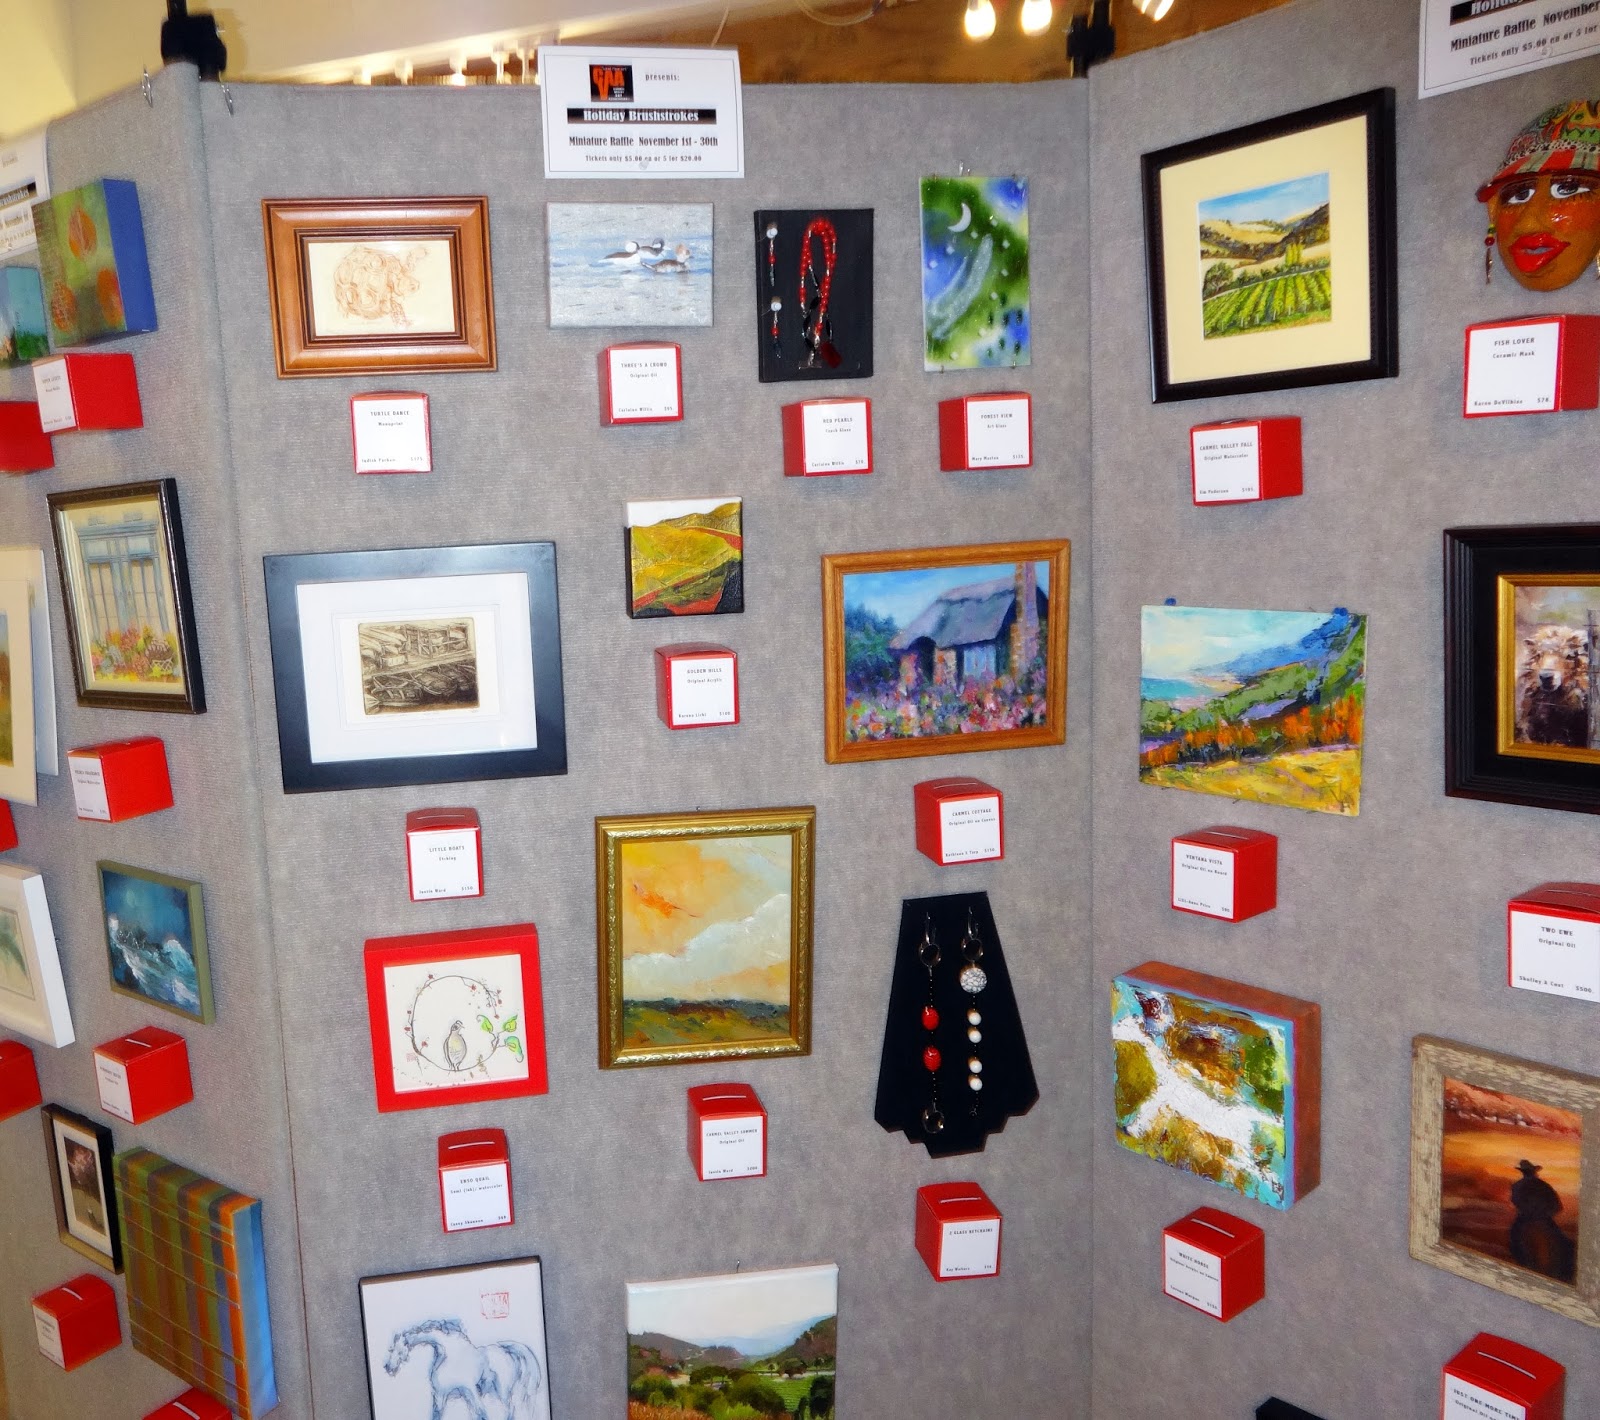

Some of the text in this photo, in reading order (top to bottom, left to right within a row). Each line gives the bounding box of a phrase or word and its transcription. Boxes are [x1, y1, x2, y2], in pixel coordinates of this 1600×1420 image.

[1450, 1, 1600, 51] Miniature Raffle November
[1470, 53, 1499, 65] Tickets
[1501, 46, 1520, 57] only
[1522, 38, 1547, 51] $5.00
[645, 73, 680, 82] presents:
[583, 109, 699, 122] Holiday Brushstrokes
[569, 136, 608, 146] Miniature
[610, 136, 634, 146] Raffle
[639, 136, 680, 146] November
[681, 136, 692, 146] 1st
[700, 136, 718, 146] 30th
[609, 156, 622, 164] only
[1512, 337, 1535, 345] LOVER
